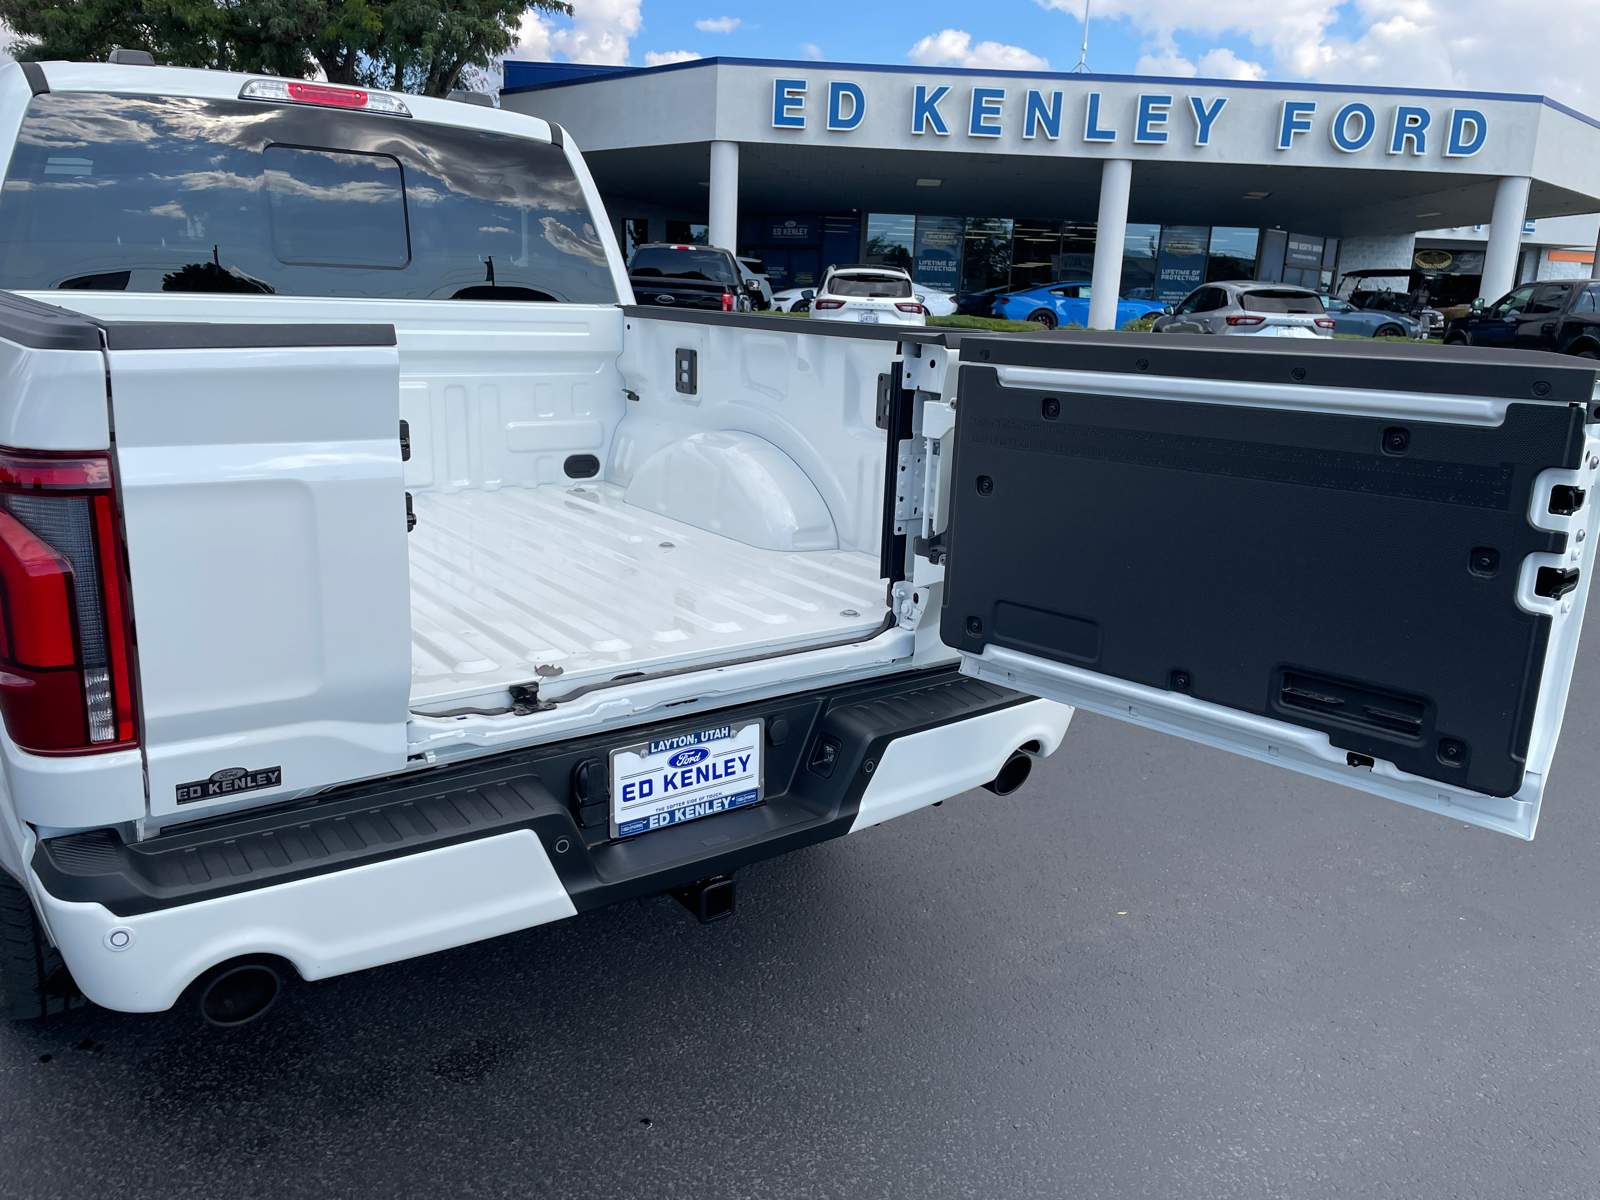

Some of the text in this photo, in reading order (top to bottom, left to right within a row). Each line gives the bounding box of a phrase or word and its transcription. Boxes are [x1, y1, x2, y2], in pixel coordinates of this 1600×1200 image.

[772, 78, 1489, 158] ED KENLEY FORD
[773, 228, 808, 236] ED KENLEY
[918, 259, 947, 267] LIFETIME
[650, 726, 730, 753] LAYTON, UTAH
[676, 751, 702, 766] Ford
[177, 770, 280, 800] ED KENLEY
[219, 771, 239, 780] Ford
[622, 754, 752, 803] ED KENLEY
[649, 796, 732, 829] ED KENLEY
[666, 801, 686, 810] SOFTER
[686, 797, 698, 805] SIDE
